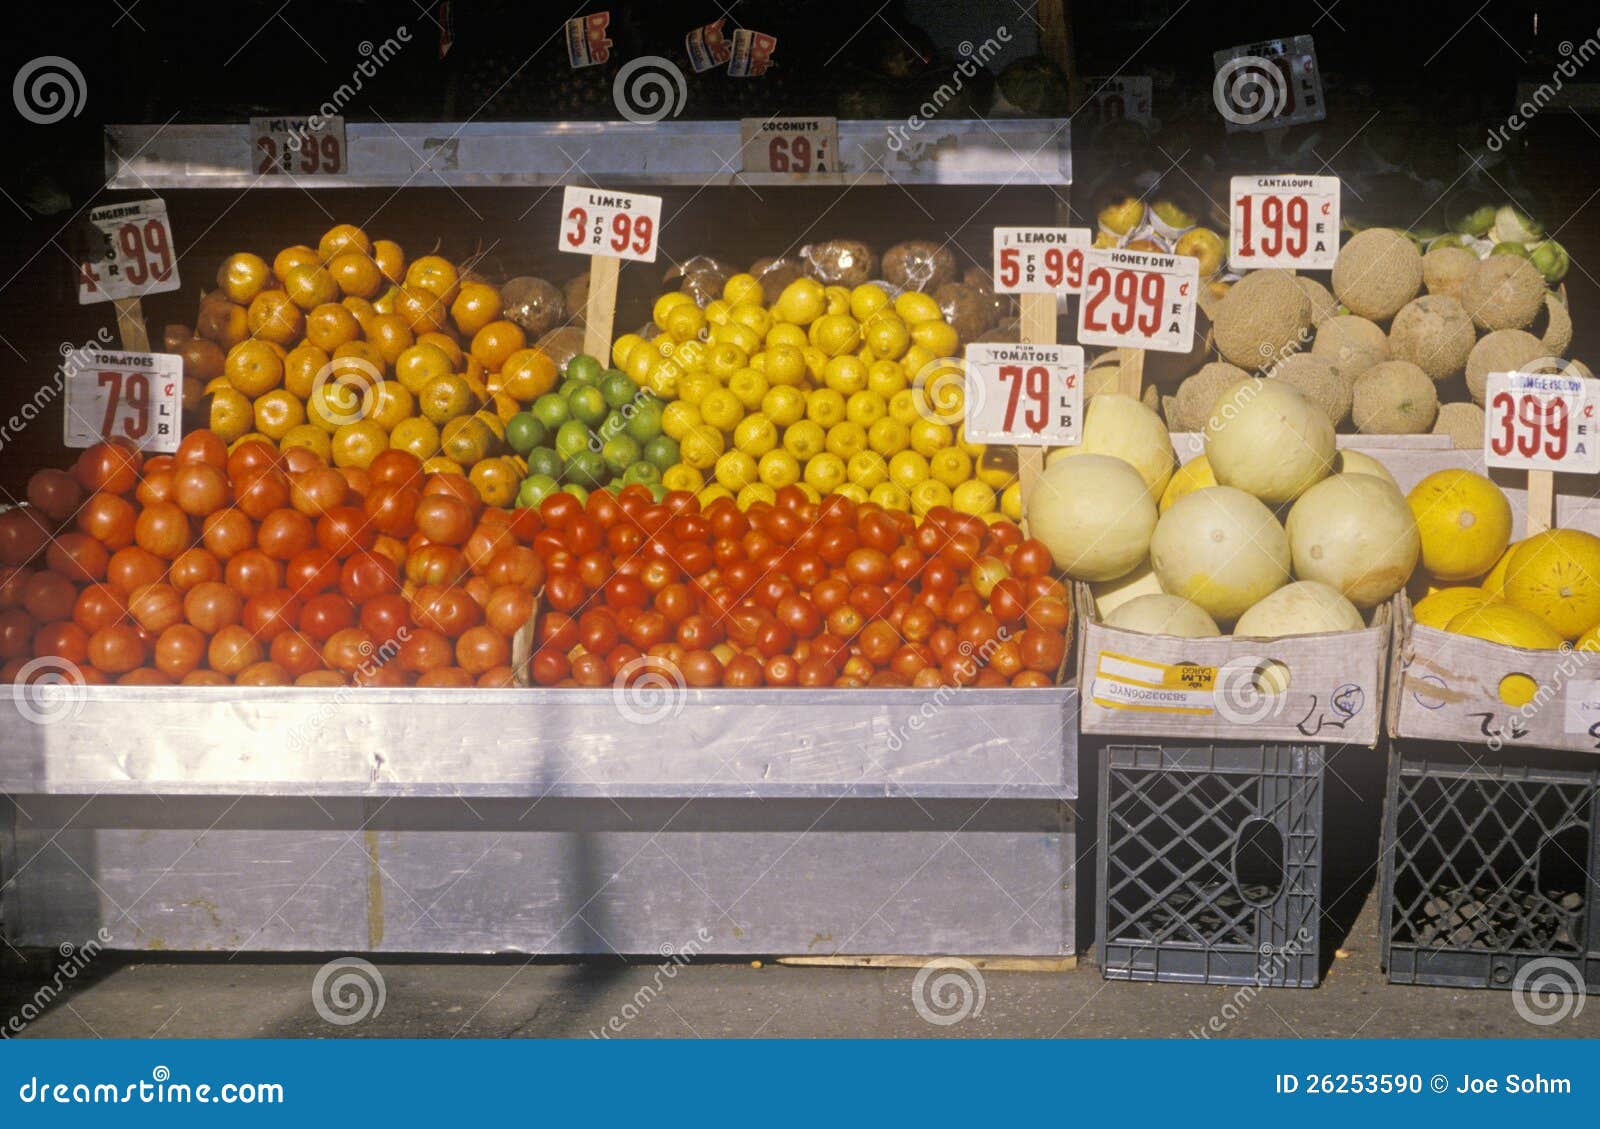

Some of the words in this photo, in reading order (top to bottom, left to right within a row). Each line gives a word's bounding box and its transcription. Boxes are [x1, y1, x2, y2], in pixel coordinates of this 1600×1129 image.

[762, 121, 818, 131] COCONUTS
[301, 135, 340, 174] 99
[769, 135, 811, 172] 69
[589, 194, 632, 209] LIMES
[1257, 179, 1313, 187] CANTALOUPE
[91, 206, 141, 221] ANGERINE
[567, 207, 587, 247] 3
[593, 216, 604, 245] FOR
[610, 212, 653, 255] 99
[1236, 195, 1308, 258] 199
[119, 219, 172, 286] 99
[1016, 233, 1067, 243] LEMON
[1000, 247, 1020, 288] 5
[1026, 254, 1036, 282] FOR
[1044, 247, 1084, 288] 99
[1111, 252, 1149, 265] HONEY
[1150, 257, 1175, 268] DEW
[1084, 267, 1165, 337] 299
[95, 354, 154, 367] TOMATOES
[992, 350, 1059, 362] TOMATOES
[98, 371, 149, 439] 79
[998, 365, 1050, 433] 79
[1491, 391, 1569, 460] 399
